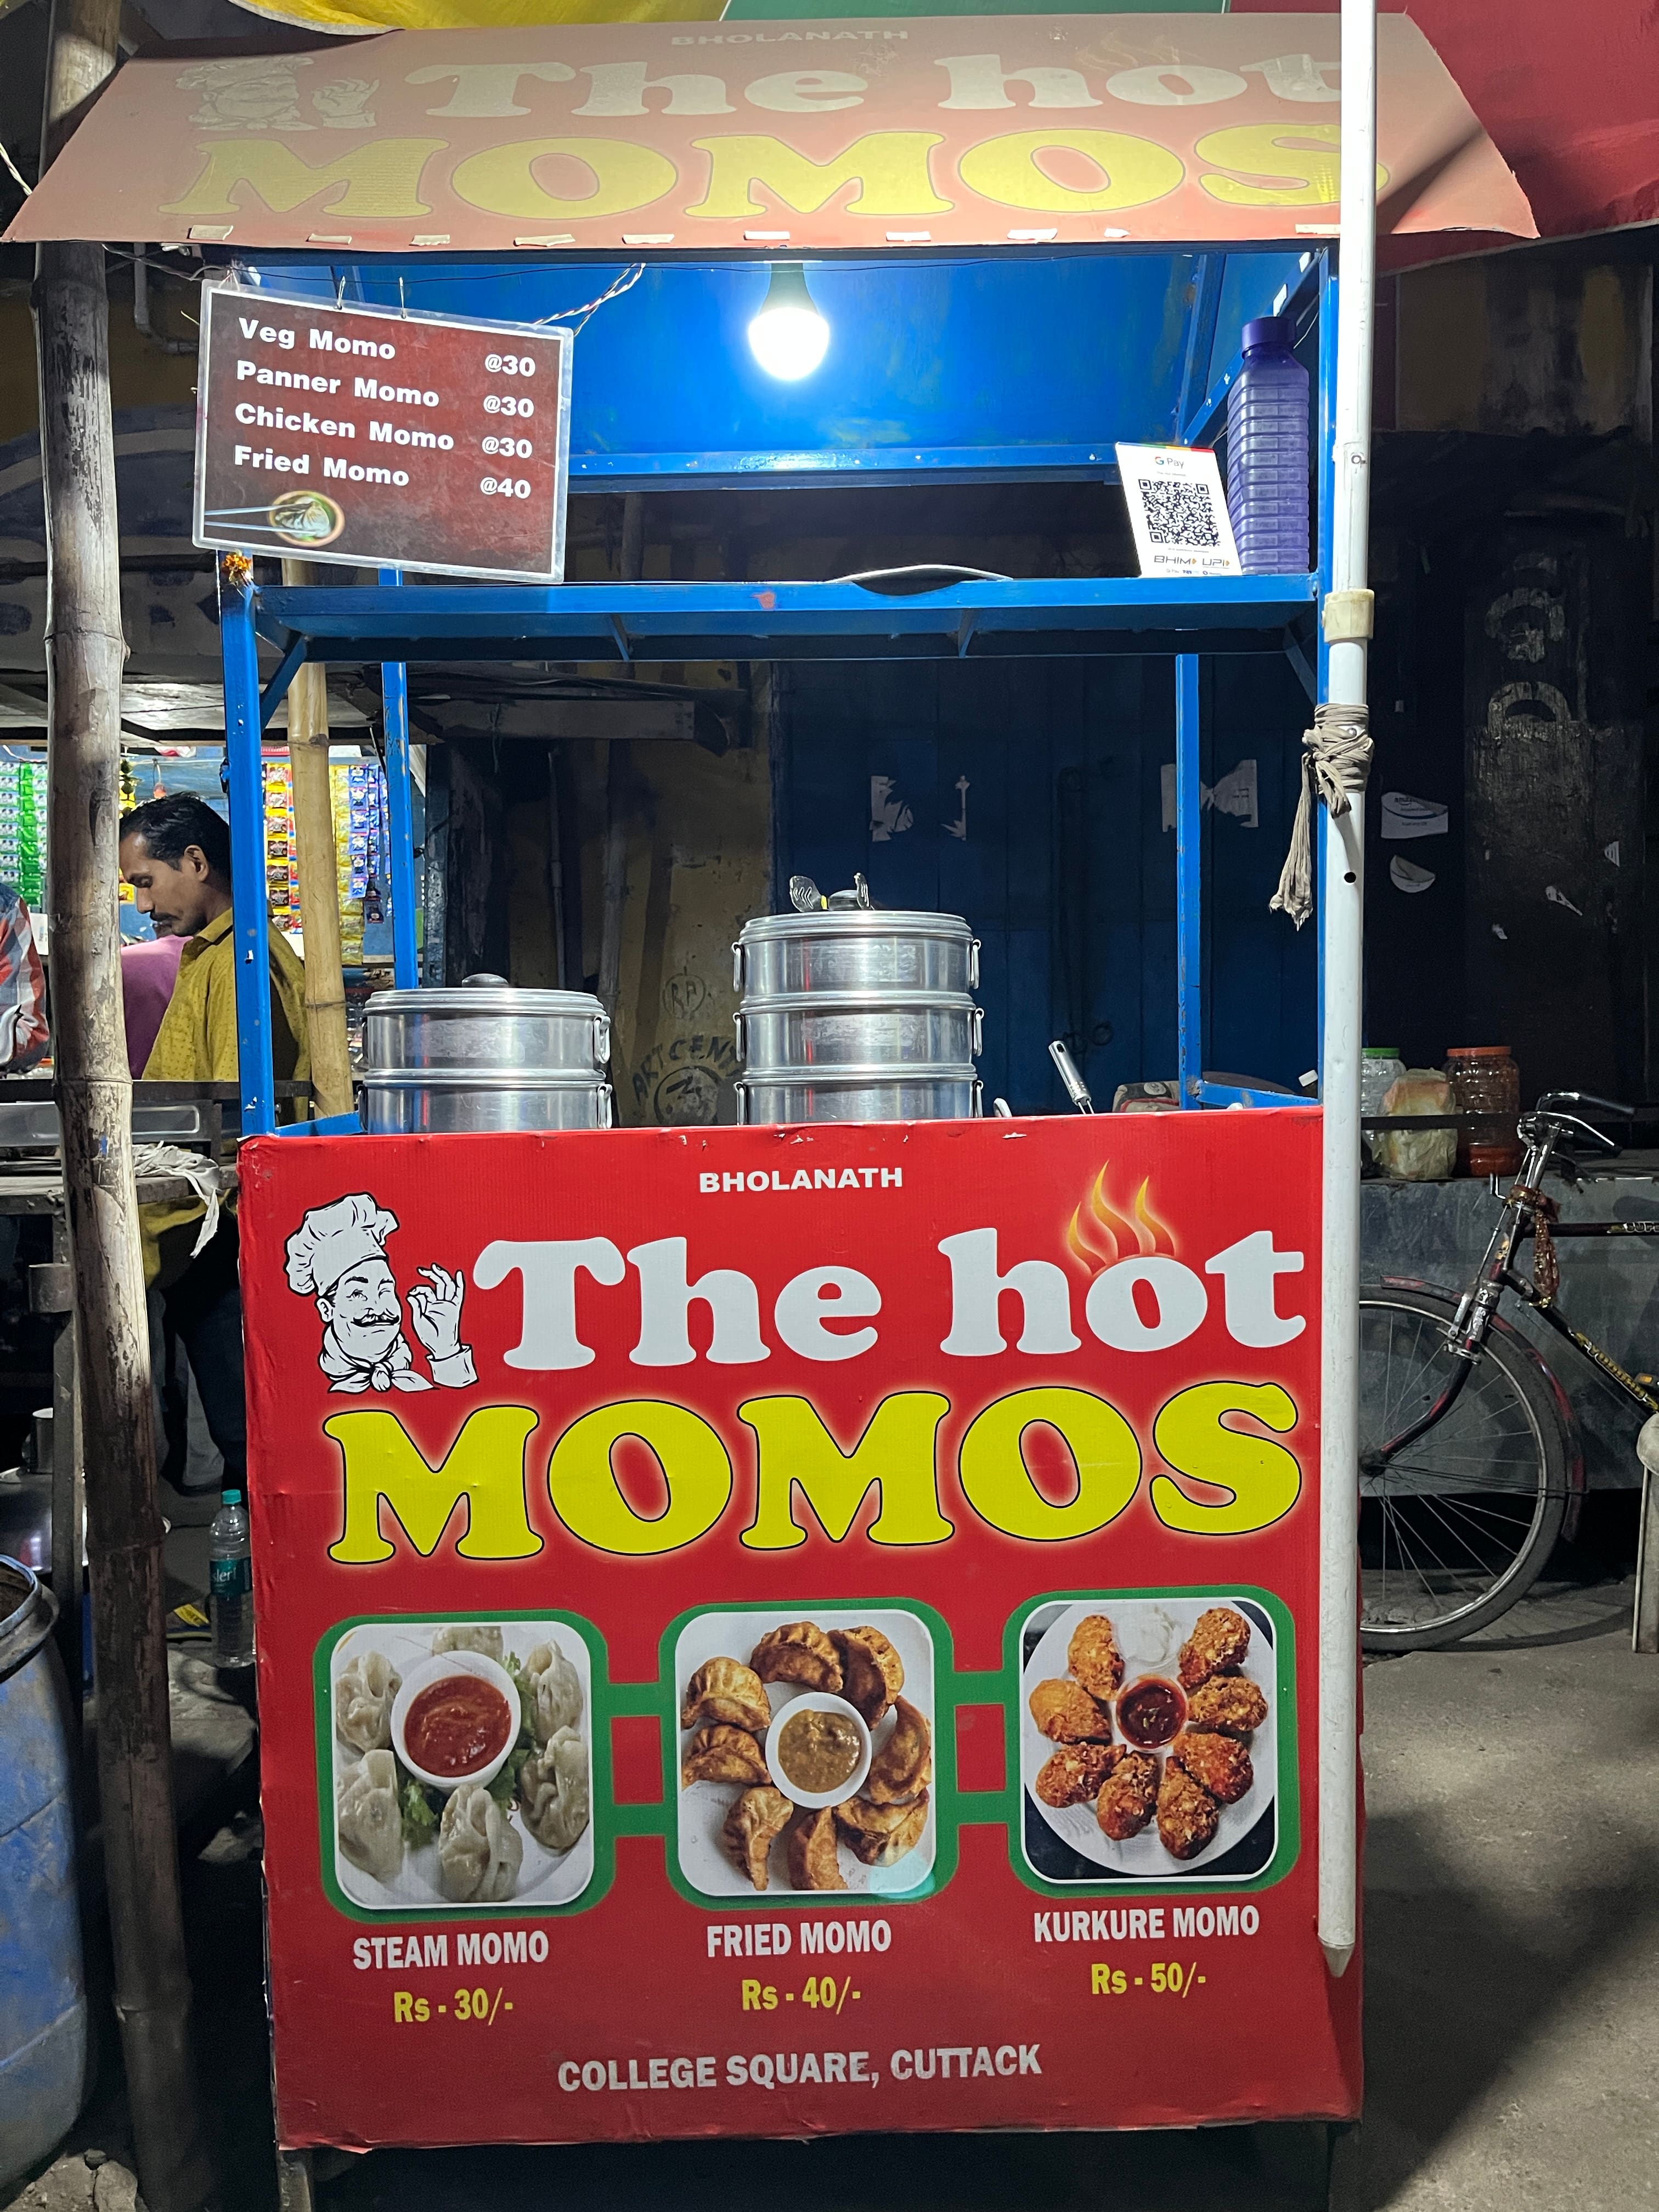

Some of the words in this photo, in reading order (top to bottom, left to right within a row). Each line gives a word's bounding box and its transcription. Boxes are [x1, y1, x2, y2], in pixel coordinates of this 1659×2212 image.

[670, 29, 909, 47] BHOLANATH
[404, 60, 869, 117] The
[934, 53, 1341, 109] hot
[157, 123, 1391, 218] MOMOS
[238, 317, 295, 349] Veg
[309, 328, 396, 360] Momo
[484, 353, 536, 377] @30
[236, 360, 341, 394] Panner
[354, 377, 439, 407] Momo
[483, 394, 534, 418] @30
[235, 403, 356, 438] Chicken
[369, 421, 454, 450] Momo
[482, 436, 533, 459] @30
[234, 444, 309, 475] Fried
[323, 456, 409, 486] Momo
[479, 477, 532, 499] @40
[1154, 456, 1164, 465] G
[1167, 458, 1184, 469] Pay
[1154, 555, 1191, 565] BHIM
[1202, 558, 1225, 567] UPI
[669, 1035, 742, 1077] CENT
[699, 1167, 903, 1193] BHOLANATH
[473, 1236, 882, 1370] The
[938, 1227, 1306, 1357] hot
[323, 1381, 1302, 1564] MOMOS
[707, 1923, 792, 1957] FRIED
[799, 1919, 892, 1954] MOMO
[1034, 1908, 1165, 1943] KURKURE
[1172, 1905, 1260, 1938] MOMO
[353, 1934, 448, 1970] STEAM
[456, 1930, 549, 1966] MOMO
[742, 1979, 778, 2010] Rs
[802, 1976, 861, 2015] 40/-
[1091, 1963, 1127, 1994] Rs
[1151, 1961, 1207, 1998] 50/-
[394, 1991, 430, 2022] Rs
[455, 1987, 514, 2025] 30/-
[557, 2056, 717, 2092] COLLEGE
[725, 2051, 879, 2089] SQUARE,
[890, 2044, 1042, 2081] CUTTACK
